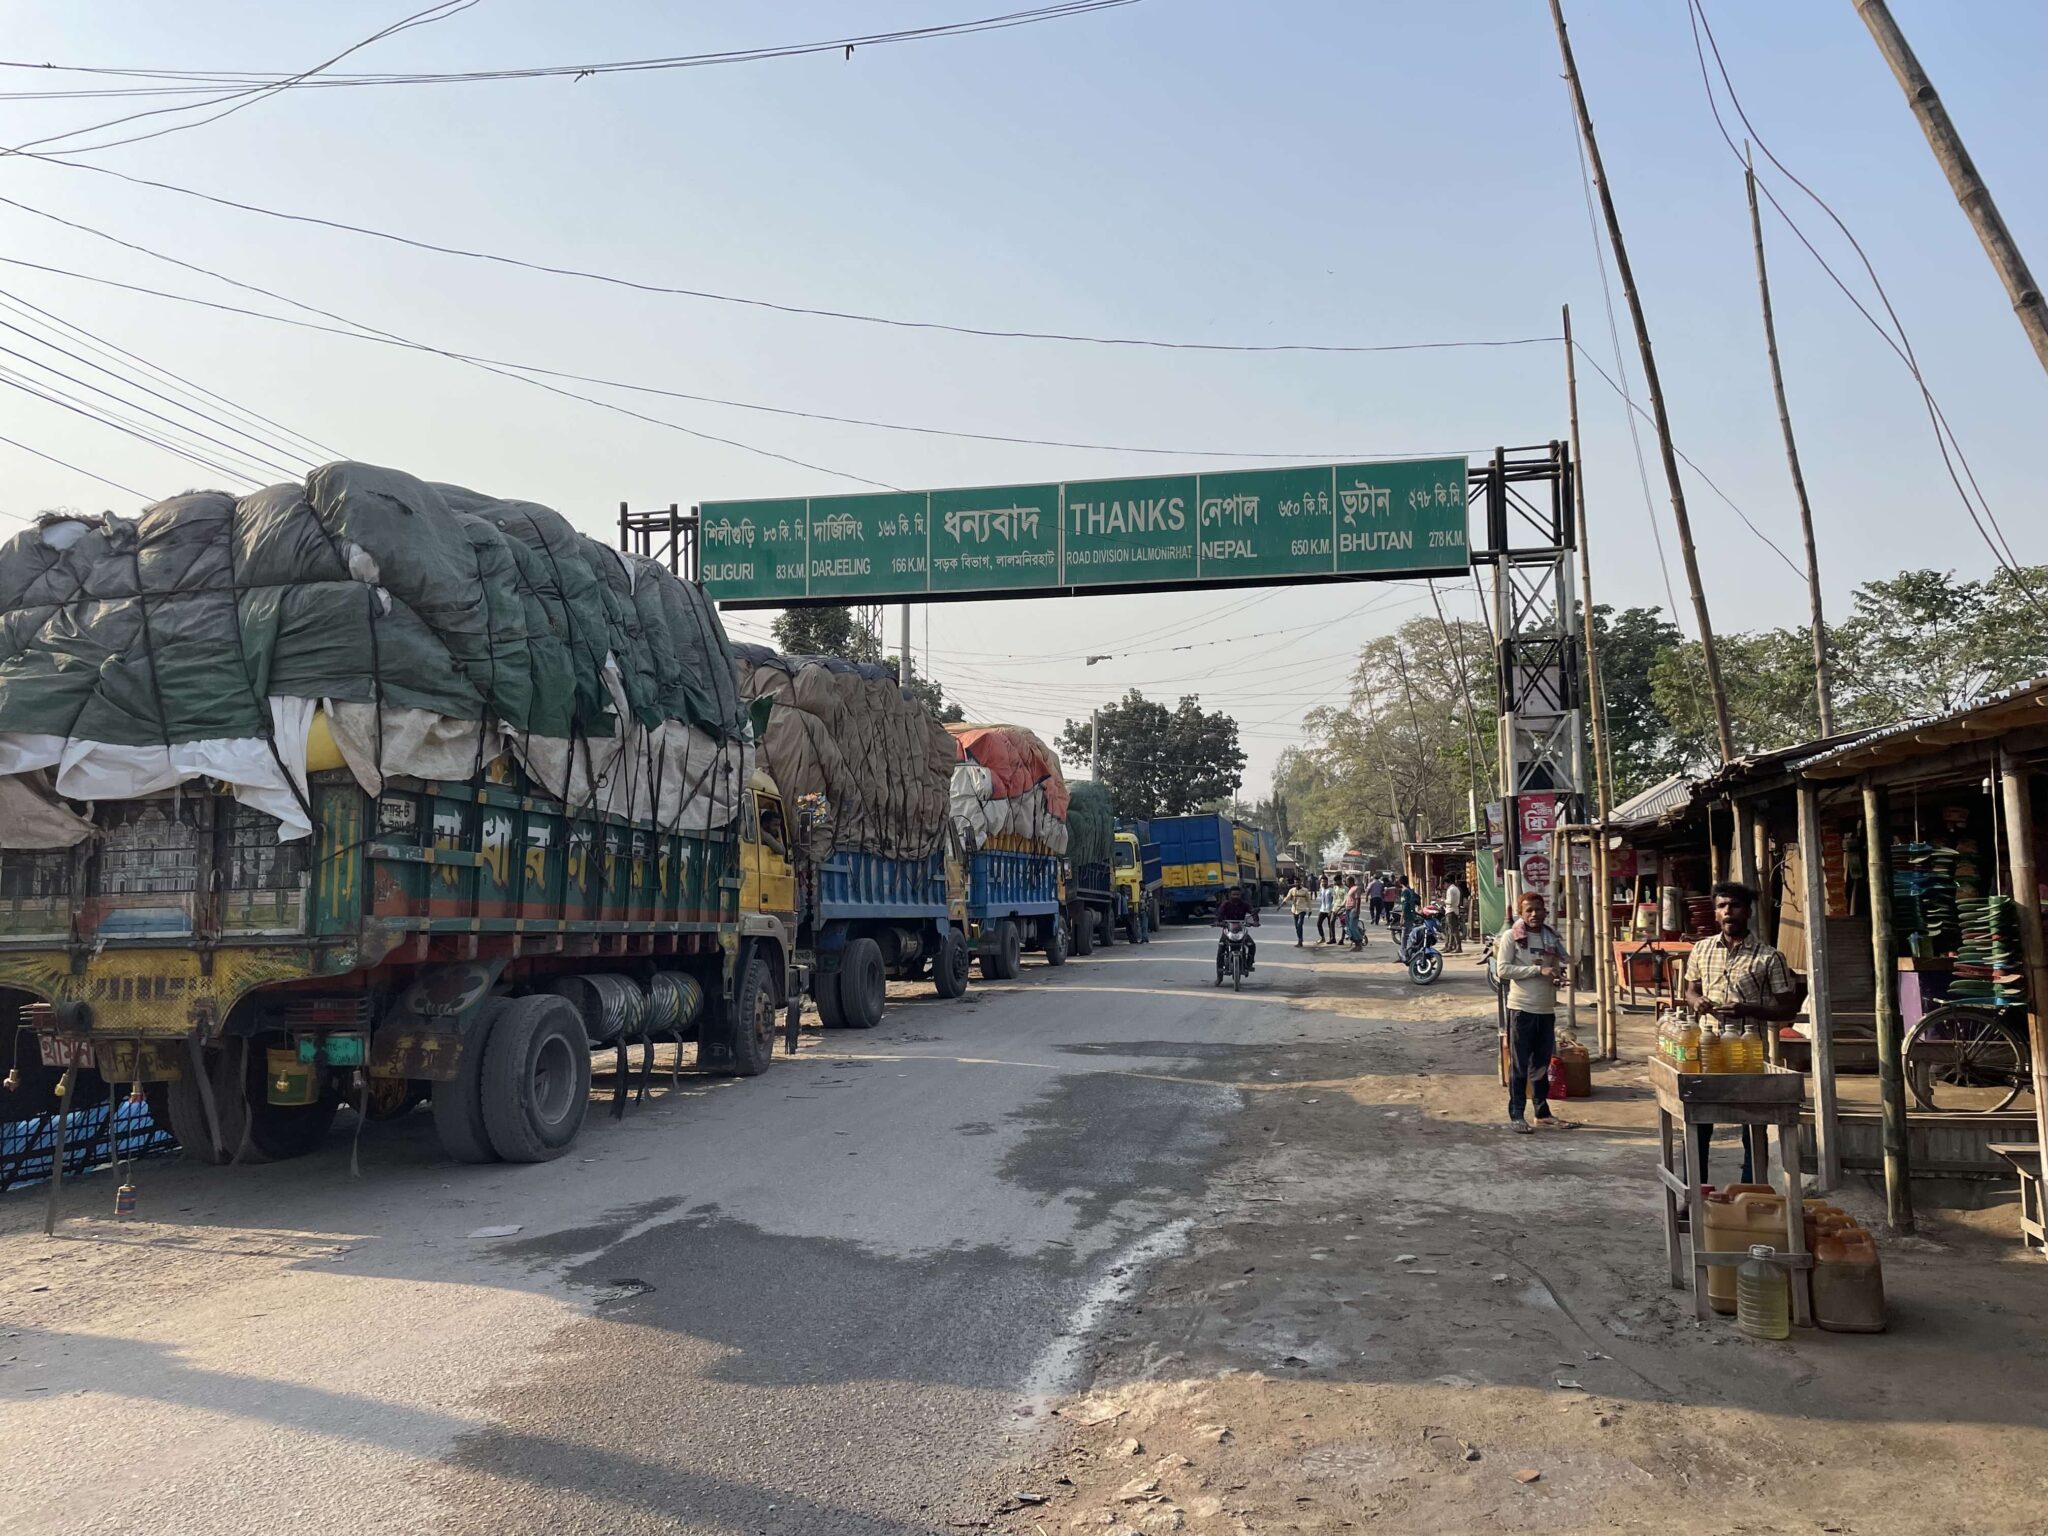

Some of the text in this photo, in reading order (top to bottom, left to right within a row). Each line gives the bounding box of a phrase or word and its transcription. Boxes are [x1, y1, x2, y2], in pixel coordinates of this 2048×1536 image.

[1070, 497, 1185, 536] THANKS
[1201, 493, 1260, 528] নেপাল
[1278, 500, 1300, 517] ৬৫০
[1339, 479, 1392, 528] ভুটান
[1408, 488, 1431, 510] ২৭৮
[703, 518, 756, 549] শিলীগুড়ি
[763, 527, 777, 542] ৮৩
[812, 513, 865, 543] দার্জিলিং
[878, 520, 897, 537] ১৬৬
[943, 503, 1041, 544] ধন্যবাদ
[1201, 539, 1332, 560] NEPAL 650 K.M.
[1340, 530, 1465, 552] BHUTAN 278 K.M.
[812, 558, 927, 577] DARJEELING 166 K.M.
[933, 557, 958, 573] সড়ক
[995, 549, 1055, 568] লালমনিরহাট
[1066, 545, 1193, 565] ROAD DIVISION LALMONIRHAT
[703, 563, 806, 582] SILIGURI 83 K.M.
